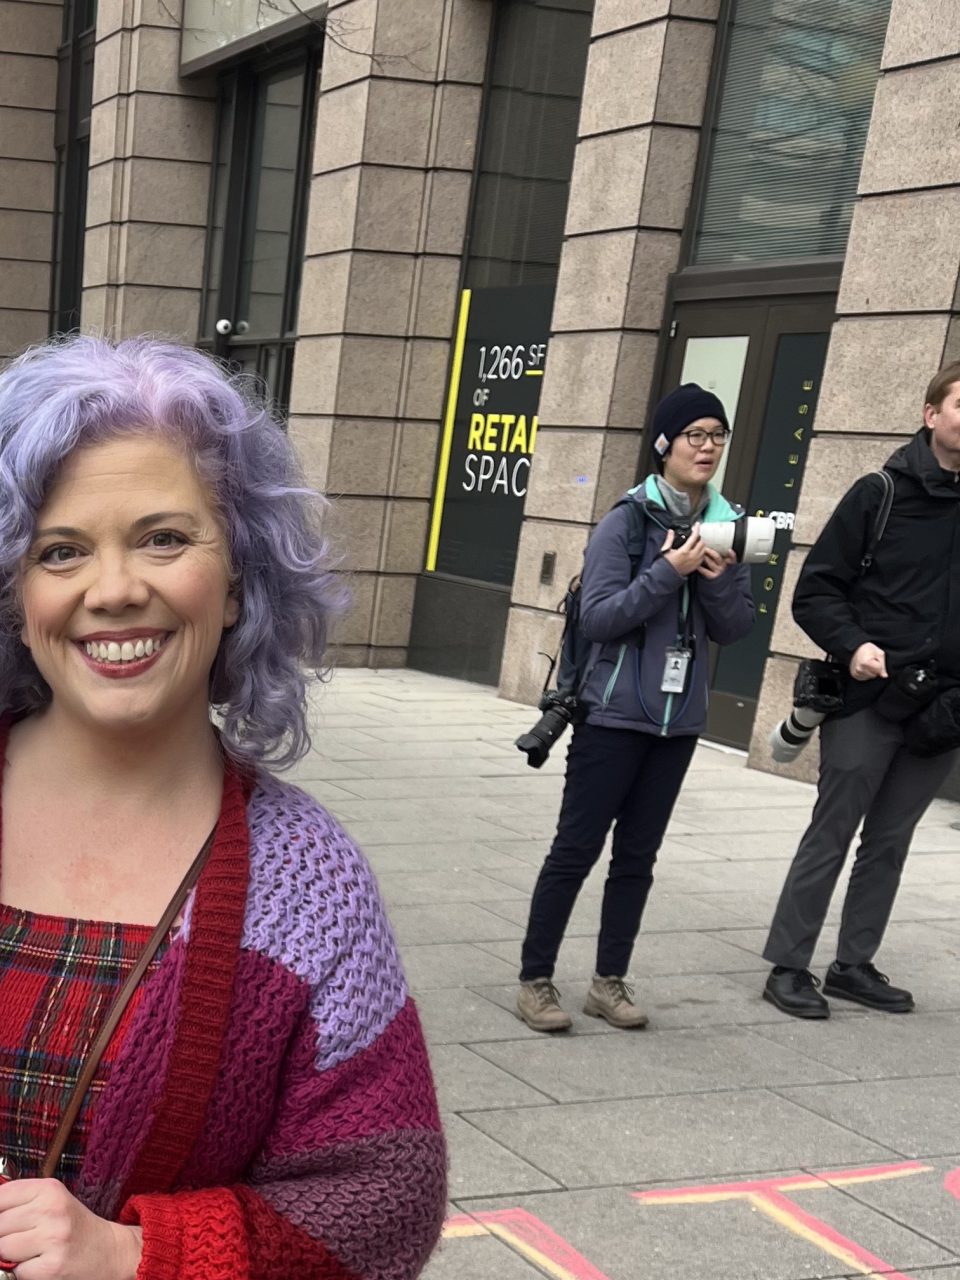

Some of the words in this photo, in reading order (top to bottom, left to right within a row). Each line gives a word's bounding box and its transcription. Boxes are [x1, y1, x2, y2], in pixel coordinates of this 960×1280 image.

[478, 345, 525, 382] 1,266
[527, 344, 547, 366] SF
[472, 388, 490, 407] OF
[467, 413, 539, 454] RETAI
[462, 453, 531, 497] SPAC
[758, 552, 780, 615] FOR
[784, 379, 814, 489] LEASE
[768, 510, 795, 529] CBR
